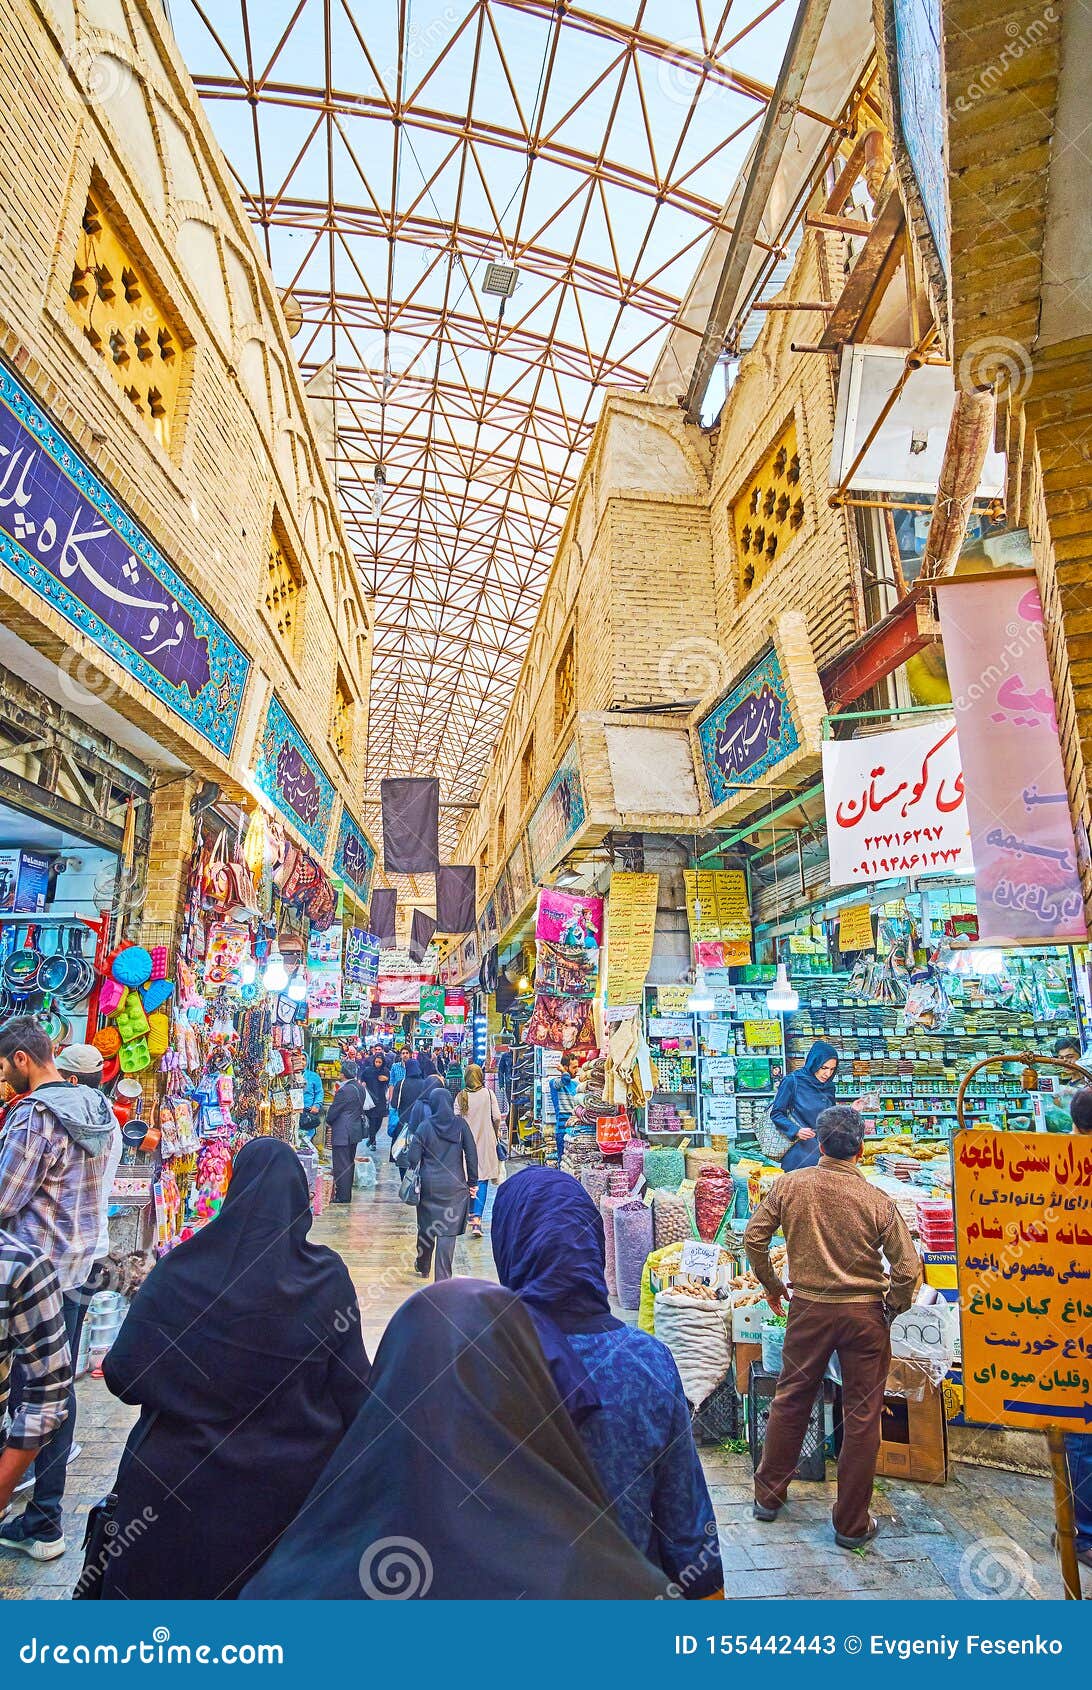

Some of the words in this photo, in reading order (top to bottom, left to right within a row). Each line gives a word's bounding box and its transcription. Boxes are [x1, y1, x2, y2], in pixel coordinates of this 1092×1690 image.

[0, 444, 37, 539] پلا
[37, 506, 184, 655] فروشگاه
[738, 691, 775, 762] فروشگاه
[836, 725, 958, 828] کوهستان
[864, 825, 944, 850] ۲۲۷۱۶۲۹۷
[960, 1137, 1004, 1180] باغچه
[1009, 1144, 1051, 1182] سنتی
[1055, 1140, 1092, 1186] وران
[978, 1190, 1045, 1207] خانوادگی
[1049, 1191, 1062, 1208] لژ
[1064, 1195, 1092, 1211] رای
[966, 1216, 1003, 1244] شام
[1008, 1219, 1049, 1246] نهار
[1055, 1222, 1092, 1245] حانه
[965, 1253, 999, 1277] باغچه
[1002, 1257, 1055, 1281] مخصوص
[1058, 1260, 1091, 1284] سنگی
[969, 1290, 1003, 1314] داغ
[1007, 1296, 1051, 1319] کباب
[1061, 1298, 1092, 1323] داغ
[984, 1331, 1059, 1355] خورشت
[1062, 1336, 1092, 1359] واع
[973, 1363, 996, 1384] ای
[1001, 1369, 1036, 1388] میوه
